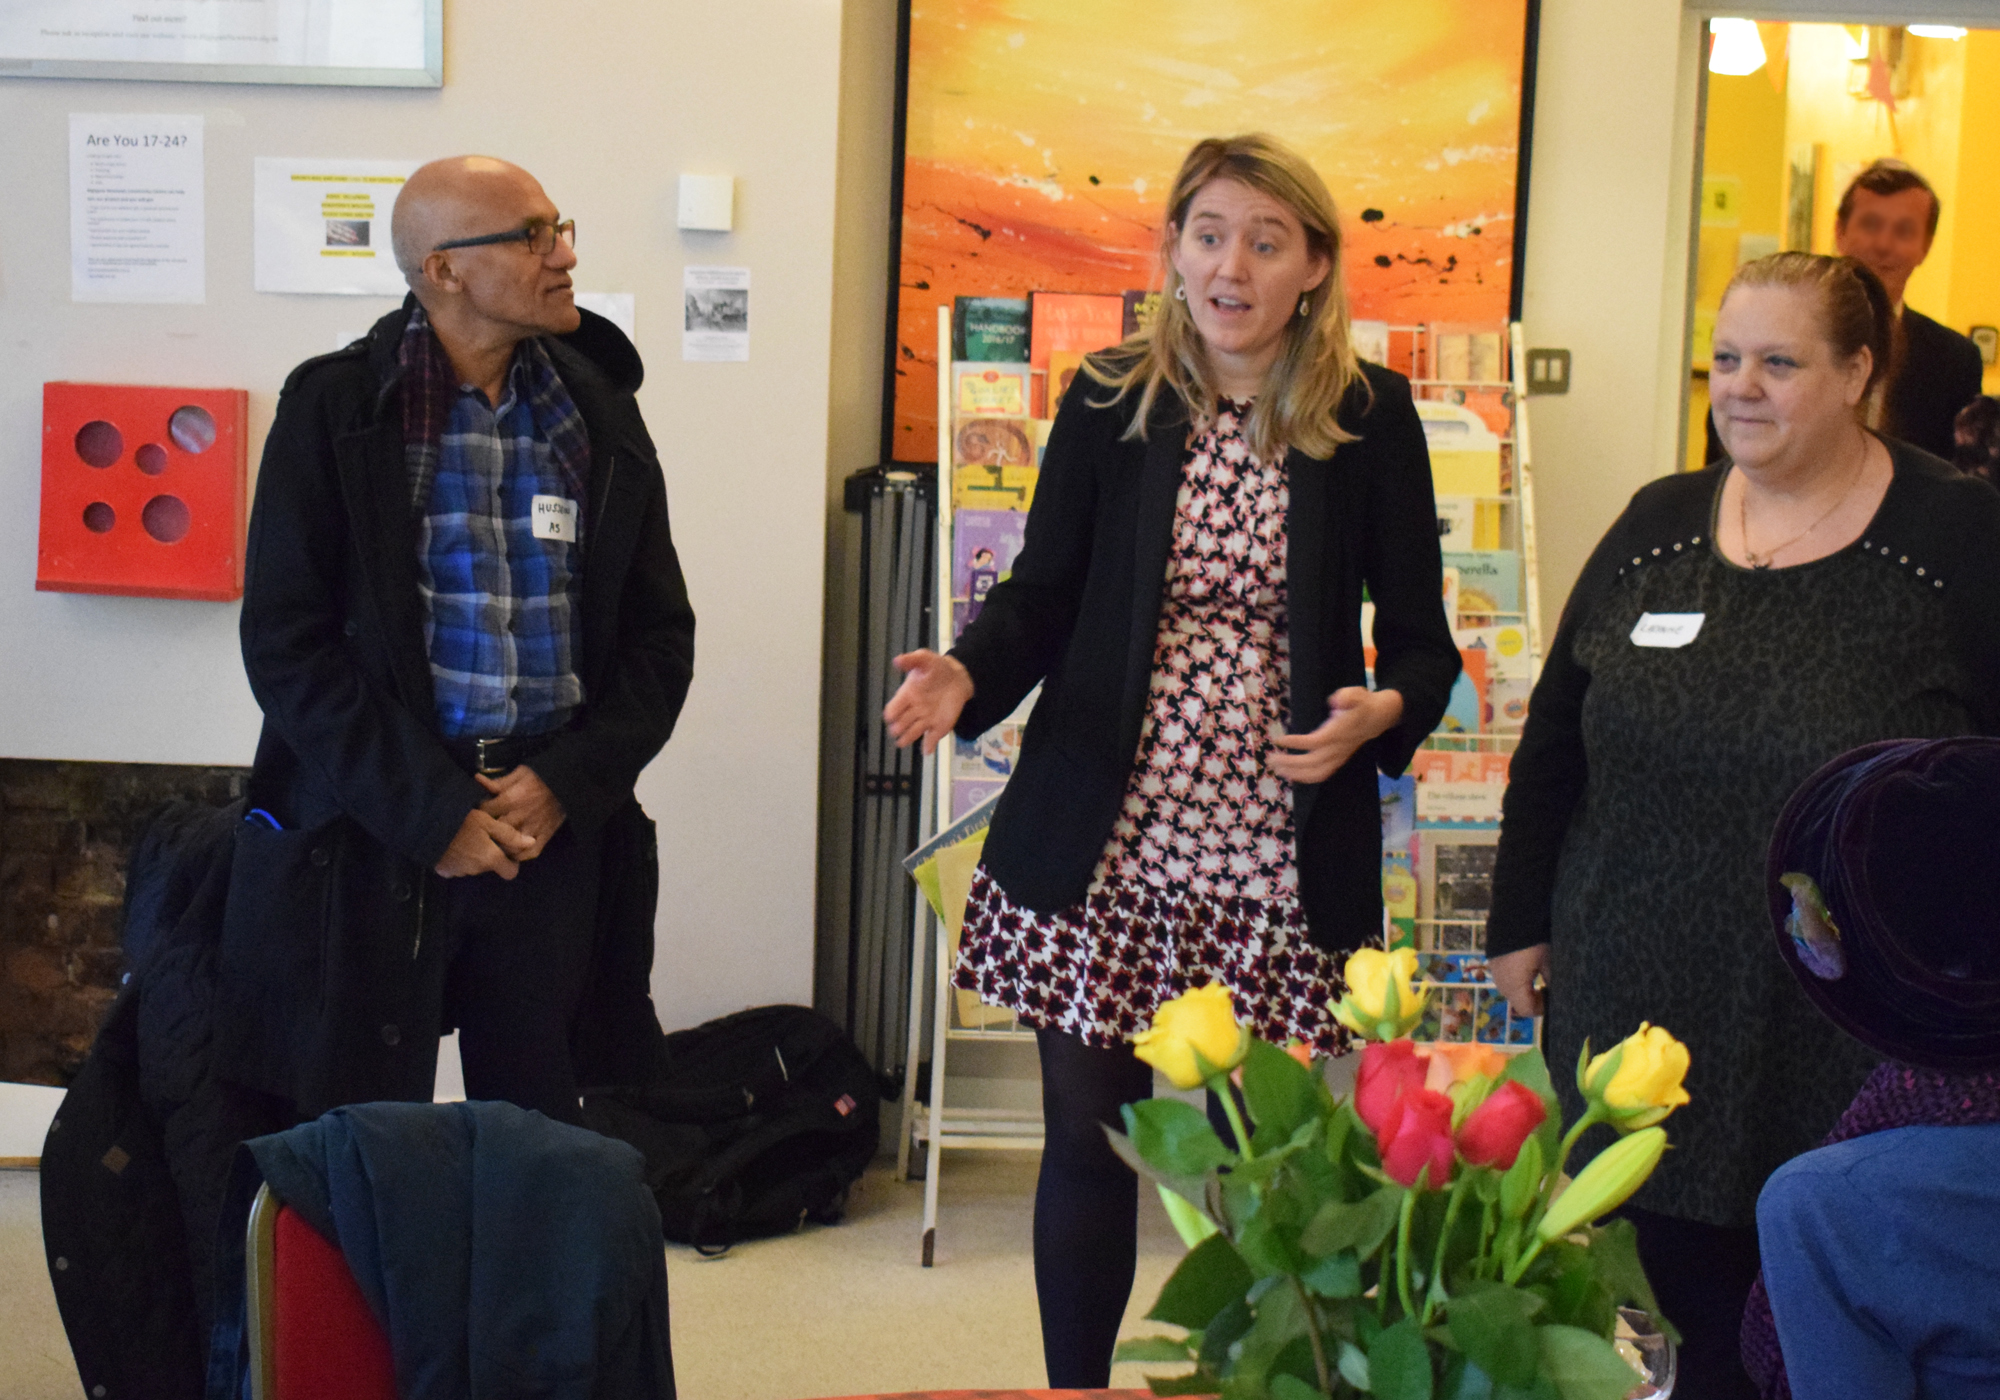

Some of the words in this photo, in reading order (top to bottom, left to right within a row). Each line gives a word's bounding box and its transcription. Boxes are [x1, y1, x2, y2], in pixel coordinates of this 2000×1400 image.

[86, 134, 110, 147] Are
[113, 134, 139, 147] You
[143, 135, 188, 148] 17-24?
[969, 322, 1026, 336] HANDBOOK
